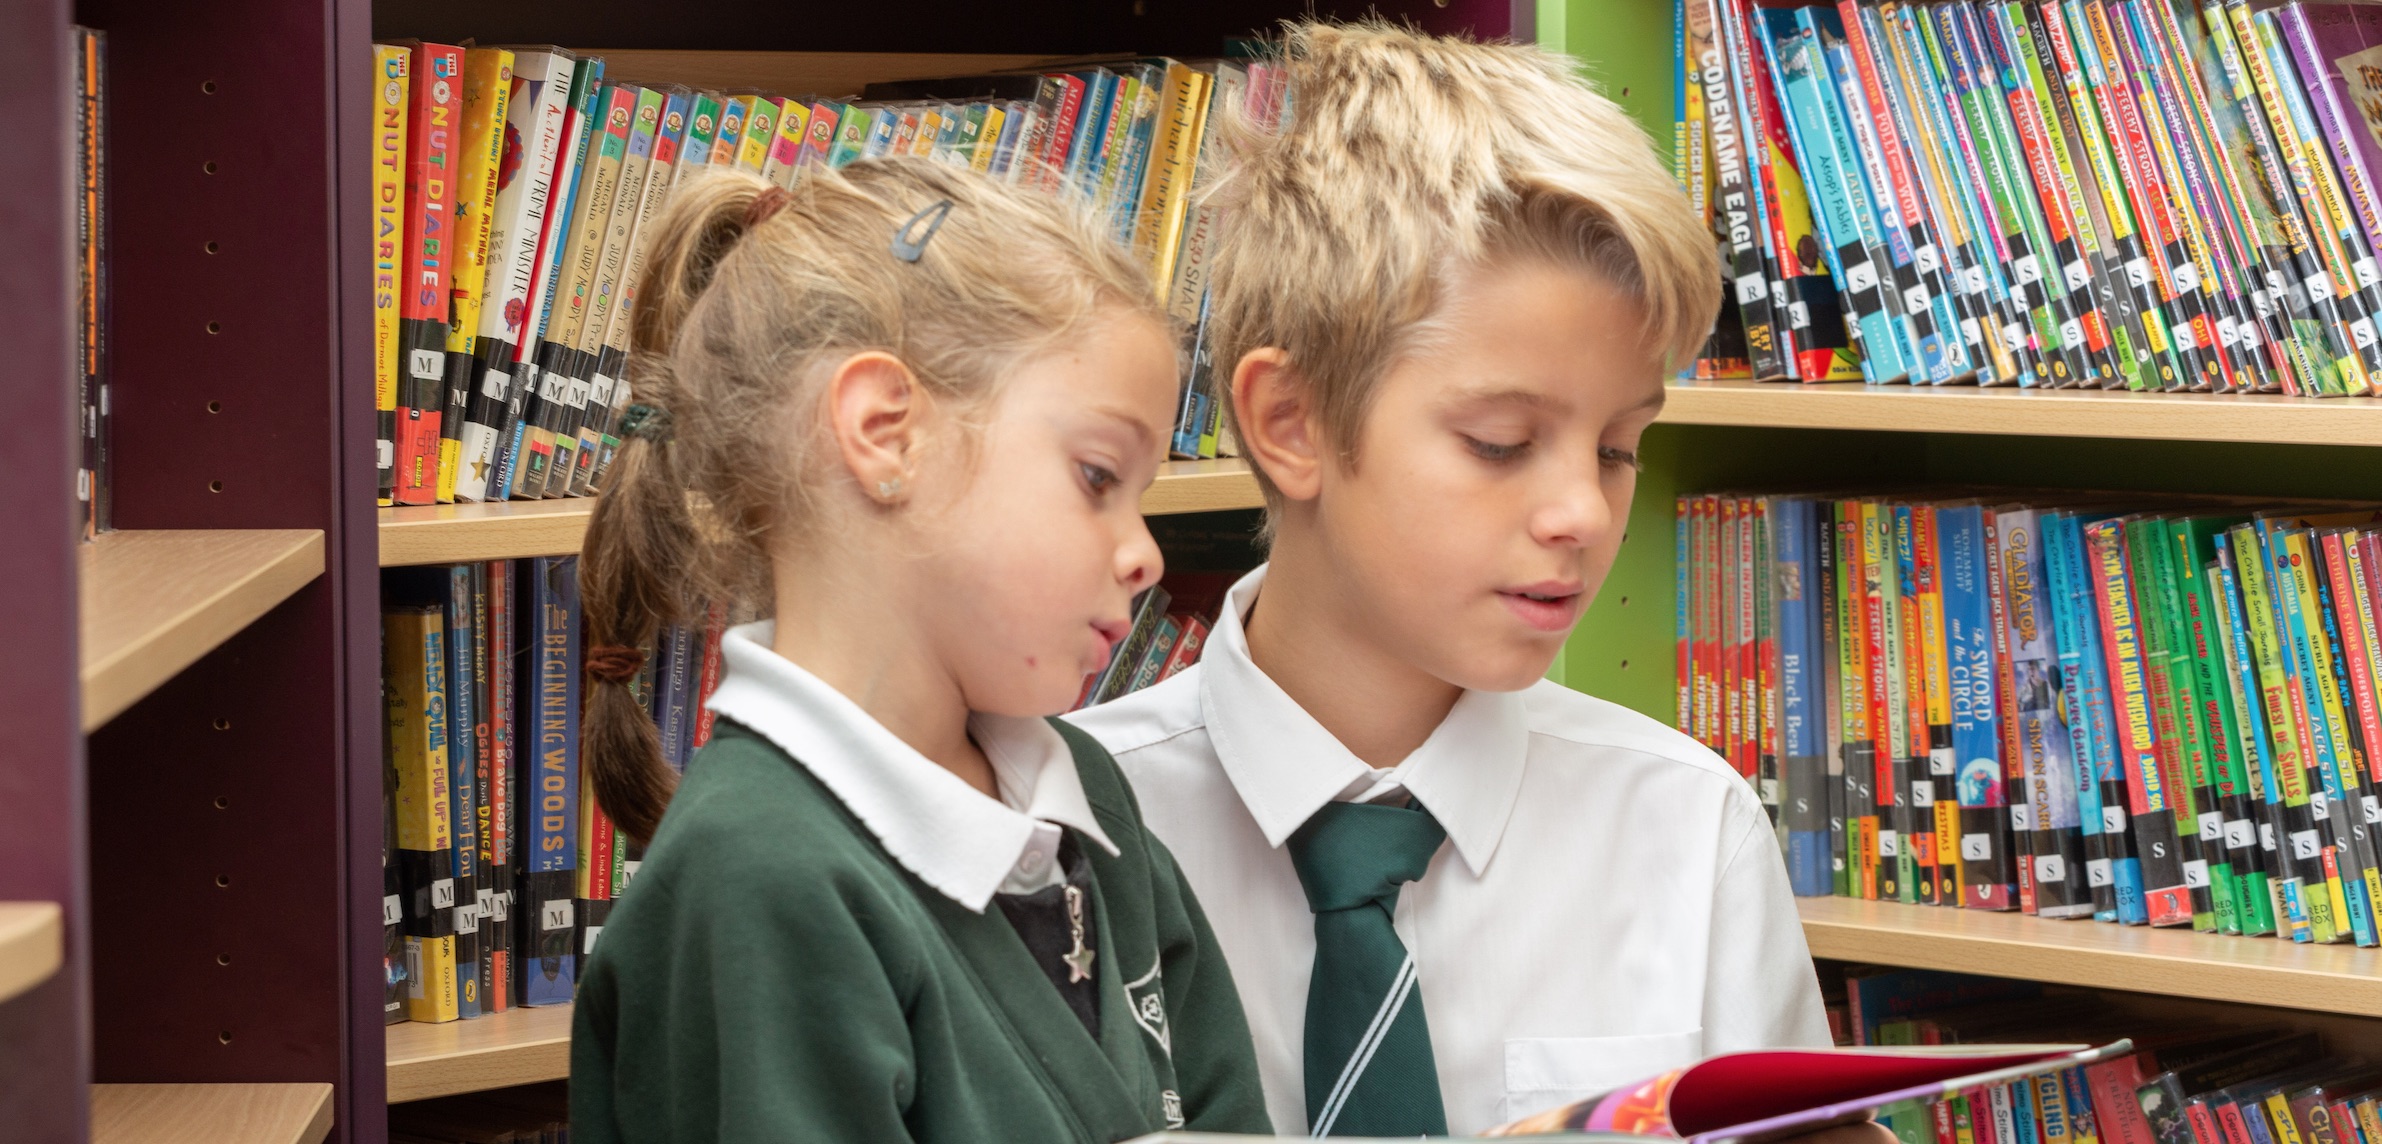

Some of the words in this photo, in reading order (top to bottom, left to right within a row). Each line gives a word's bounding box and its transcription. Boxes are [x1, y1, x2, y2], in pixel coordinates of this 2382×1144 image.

[2031, 21, 2051, 66] MACBETH
[554, 72, 568, 95] THE
[2047, 70, 2063, 91] AND
[2054, 93, 2067, 112] ALL
[382, 59, 401, 171] DONUT
[429, 58, 450, 169] DONUT
[496, 89, 506, 125] STUNT
[581, 113, 593, 140] MEGA
[1162, 81, 1193, 165] michael
[1845, 9, 1870, 68] CATHERINE
[1864, 70, 1879, 106] STORR
[1875, 112, 1897, 157] POLLY
[1899, 186, 1917, 226] WOLF
[2021, 42, 2034, 59] USA
[2041, 99, 2056, 133] SECRET
[2051, 136, 2067, 164] AGENT
[2063, 172, 2087, 209] JACK
[2063, 115, 2075, 138] THAT
[576, 142, 588, 166] QUIZ
[1690, 121, 1702, 173] SOCCER
[1700, 49, 1741, 187] CODENAME
[1726, 191, 1752, 255] EAGL
[1968, 99, 1988, 140] JEREMY
[1984, 149, 2004, 192] STRONG
[2014, 98, 2035, 140] JEREMY
[2030, 149, 2050, 192] STRONG
[2075, 98, 2096, 139] JEREMY
[2090, 146, 2112, 191] STRONG
[2161, 91, 2184, 134] JEREMY
[2178, 140, 2201, 187] STRONG
[2236, 19, 2270, 85] JEREMY
[2264, 88, 2301, 159] STRONG
[2329, 258, 2346, 285] KID
[2242, 103, 2269, 147] JEREMY
[2262, 155, 2288, 200] STRONG
[484, 168, 497, 208] MEDAL
[588, 167, 605, 221] McDONALD
[616, 163, 634, 217] McDONALD
[627, 176, 641, 211] MEGAN
[1836, 136, 1850, 164] AGENT
[1846, 172, 1866, 207] JACK
[2089, 4, 2112, 56] BANDAGES!
[2116, 91, 2139, 134] JEREMY
[2134, 142, 2157, 187] STRONG
[2193, 318, 2208, 342] OH!
[526, 179, 548, 220] PRIME
[599, 179, 613, 215] MEGAN
[1819, 155, 1841, 195] Aesop's
[1831, 199, 1852, 235] Fables
[378, 182, 397, 309] DIARIES
[421, 179, 445, 307] DIARIES
[476, 213, 490, 266] MAYHEM
[512, 228, 538, 294] MINISTER
[579, 245, 595, 275] JUDY
[605, 244, 622, 274] JUDY
[631, 249, 644, 273] JUDY
[1891, 231, 1908, 264] ELLIE
[568, 275, 588, 323] MOODY
[594, 275, 615, 321] MOODY
[618, 277, 637, 323] MOODY
[1745, 286, 1758, 300] R
[2071, 273, 2082, 287] S
[2101, 285, 2113, 301] S
[380, 319, 388, 328] of
[2119, 301, 2131, 316] S
[378, 332, 389, 370] Dermot
[417, 357, 432, 373] M
[2291, 337, 2315, 386] TAMARIND
[451, 390, 467, 407] M
[493, 383, 509, 401] M
[510, 422, 523, 460] ANDERSEN
[505, 463, 513, 485] PRESS
[1915, 509, 1932, 562] DYNAMITE!
[1987, 542, 1998, 569] SECRET
[1960, 528, 1973, 594] ROSEMARY
[2102, 551, 2123, 576] GYM
[2244, 557, 2259, 597] Charlie
[475, 593, 486, 640] KIRSTY
[544, 604, 568, 630] The
[1870, 602, 1882, 649] JEREMY
[1922, 600, 1938, 646] JEREMY
[2107, 578, 2132, 627] TEACHER
[2252, 600, 2266, 627] Small
[2008, 527, 2039, 651] GLADIATOR
[2028, 719, 2048, 775] SIMON
[2115, 628, 2133, 641] IS
[2118, 642, 2136, 658] AN
[2259, 631, 2271, 666] Journals
[2328, 544, 2348, 611] CATHERINE
[2343, 614, 2358, 652] STORR
[2358, 691, 2375, 730] POLLY
[425, 633, 444, 694] WENDY
[457, 648, 470, 672] Jill
[476, 647, 486, 683] McKAY
[1784, 654, 1801, 709] Black
[1873, 655, 1885, 701] STRONG
[2120, 661, 2143, 692] ALIEN
[2281, 572, 2298, 615] AUSTRALIA
[2295, 636, 2308, 672] SECRET
[2310, 713, 2326, 755] JACK
[2295, 570, 2307, 595] CHINA
[2310, 634, 2325, 671] SECRET
[2319, 673, 2333, 705] AGENT
[2327, 712, 2344, 753] JACK
[543, 635, 567, 742] BEGINNING
[1951, 665, 1974, 731] CIRCLE
[1969, 650, 1993, 721] SWORD
[2264, 685, 2287, 726] FOREST
[424, 696, 446, 751] QUILL
[457, 680, 471, 748] Murphy
[667, 705, 683, 756] Kaspar
[2124, 694, 2152, 750] OVERLORD
[2206, 699, 2229, 762] WHISPER
[2274, 731, 2289, 743] OF
[475, 723, 489, 779] OGRES
[497, 749, 506, 796] Brave
[433, 768, 445, 798] FULL
[2141, 758, 2158, 791] DAVID
[2277, 751, 2302, 799] SKULLS
[434, 802, 447, 819] UP
[458, 785, 472, 831] Dear
[542, 749, 565, 851] WOODS
[1796, 798, 1809, 813] S
[2014, 811, 2026, 825] S
[459, 832, 474, 878] Hou
[477, 805, 491, 860] DANCE
[615, 836, 625, 874] McCALL
[1971, 842, 1983, 857] S
[2302, 840, 2313, 855] S
[439, 888, 453, 904] M
[550, 911, 565, 927] M
[2122, 1091, 2140, 1125] NOEL
